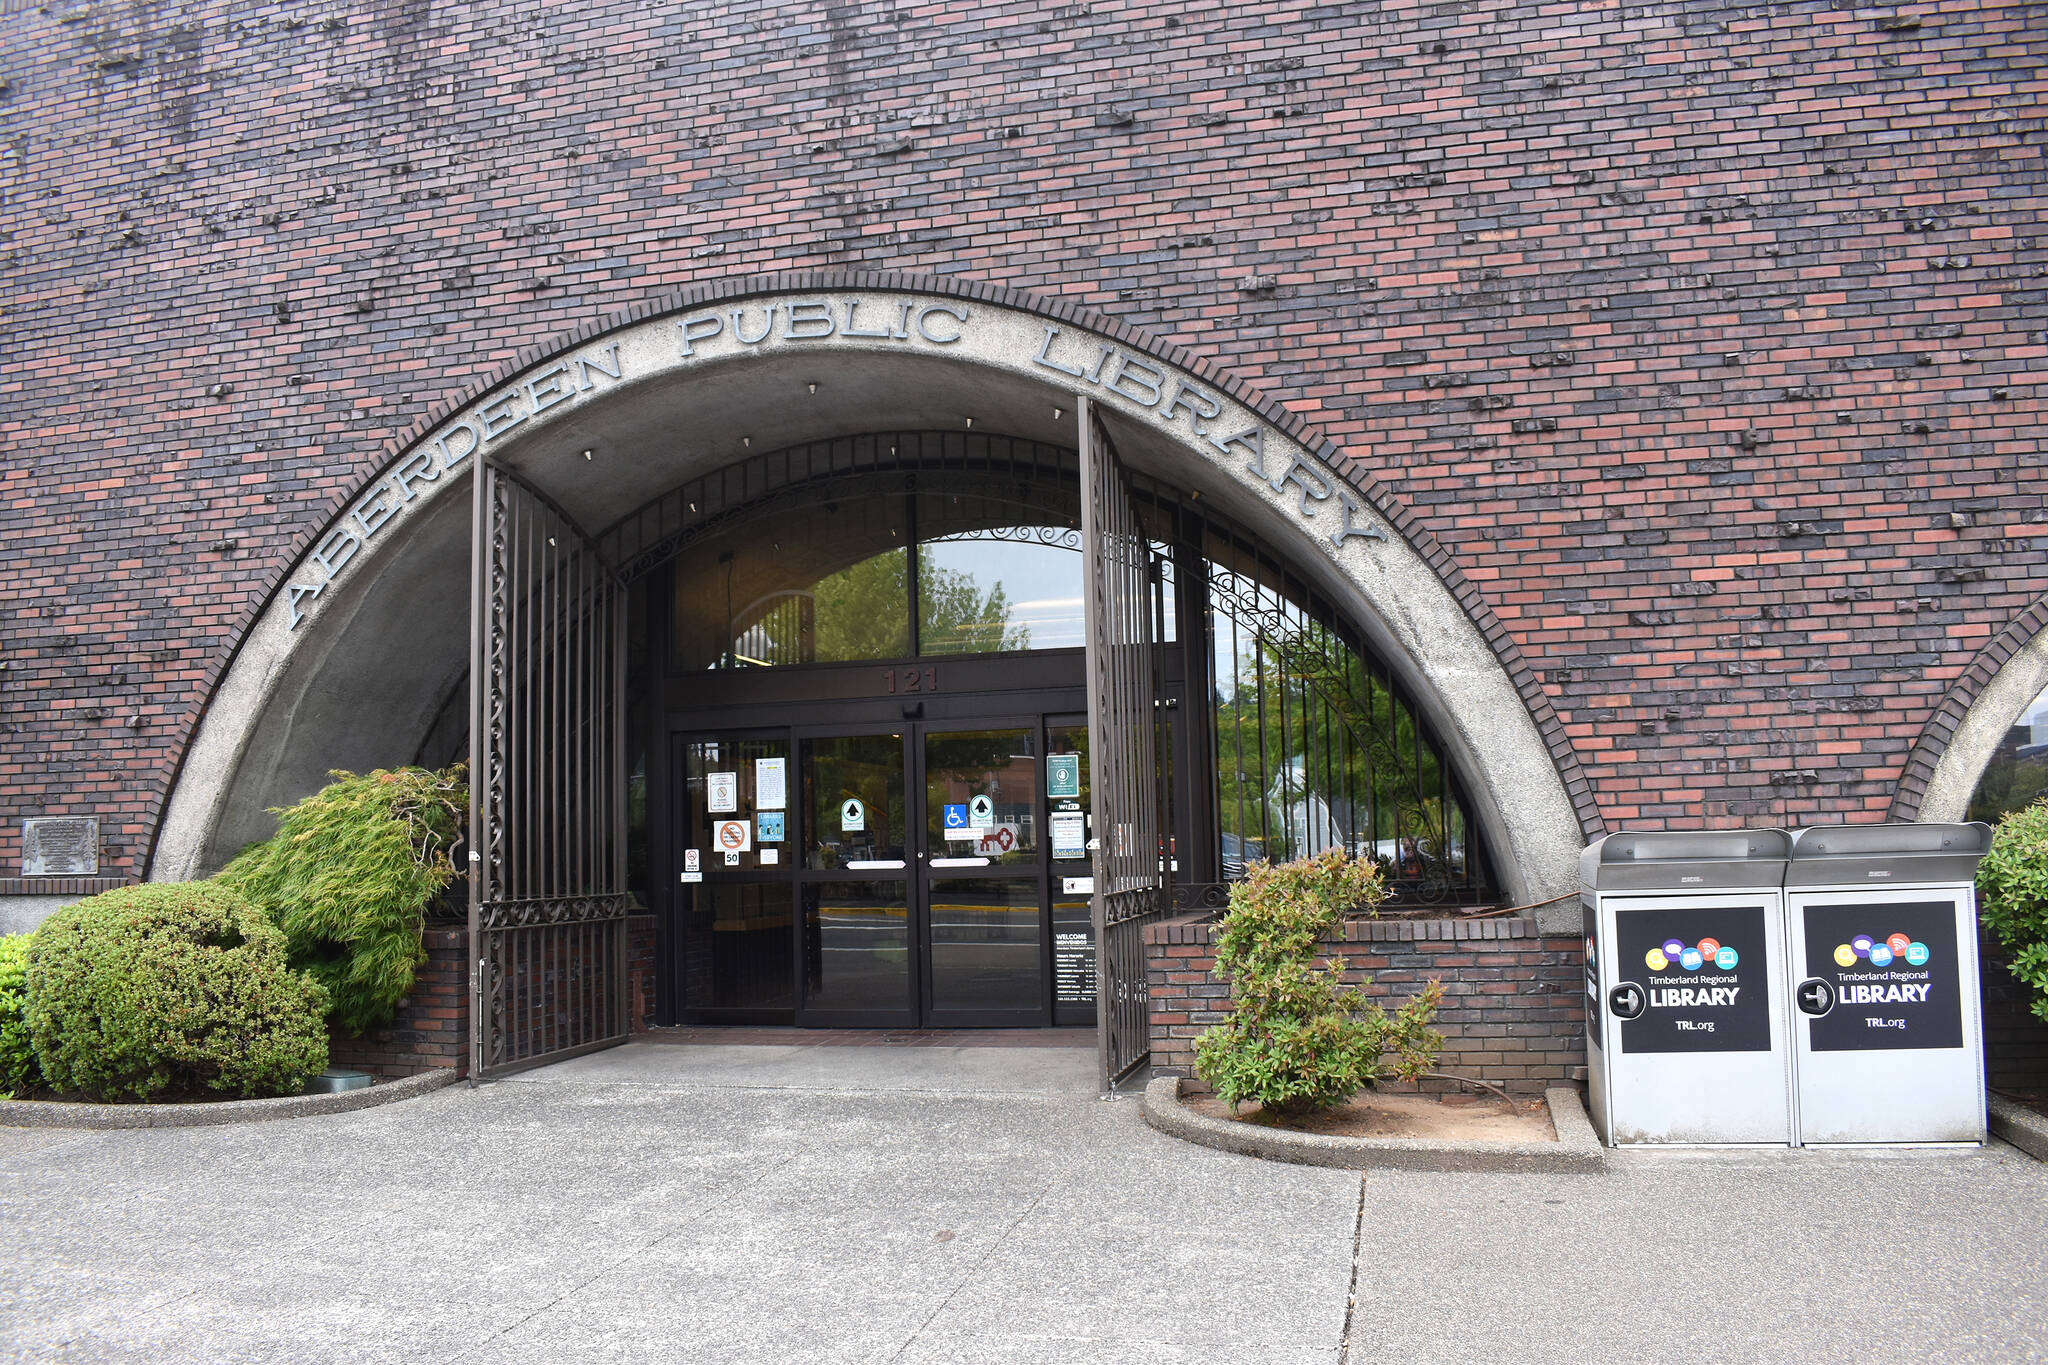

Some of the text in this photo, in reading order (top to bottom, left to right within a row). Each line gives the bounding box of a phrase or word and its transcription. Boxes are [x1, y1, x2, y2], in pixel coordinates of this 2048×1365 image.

[288, 299, 1388, 631] ABERDEEN PUBLIC LIBRARY
[882, 666, 937, 693] 121
[726, 853, 738, 862] 50
[1649, 974, 1738, 985] Timberland Regional
[1837, 970, 1929, 981] Timberland Regional
[1650, 987, 1740, 1007] LIBRARY
[1838, 983, 1932, 1004] LIBRARY
[1675, 1020, 1715, 1032] TRL.org
[1865, 1018, 1906, 1029] TRL.org
